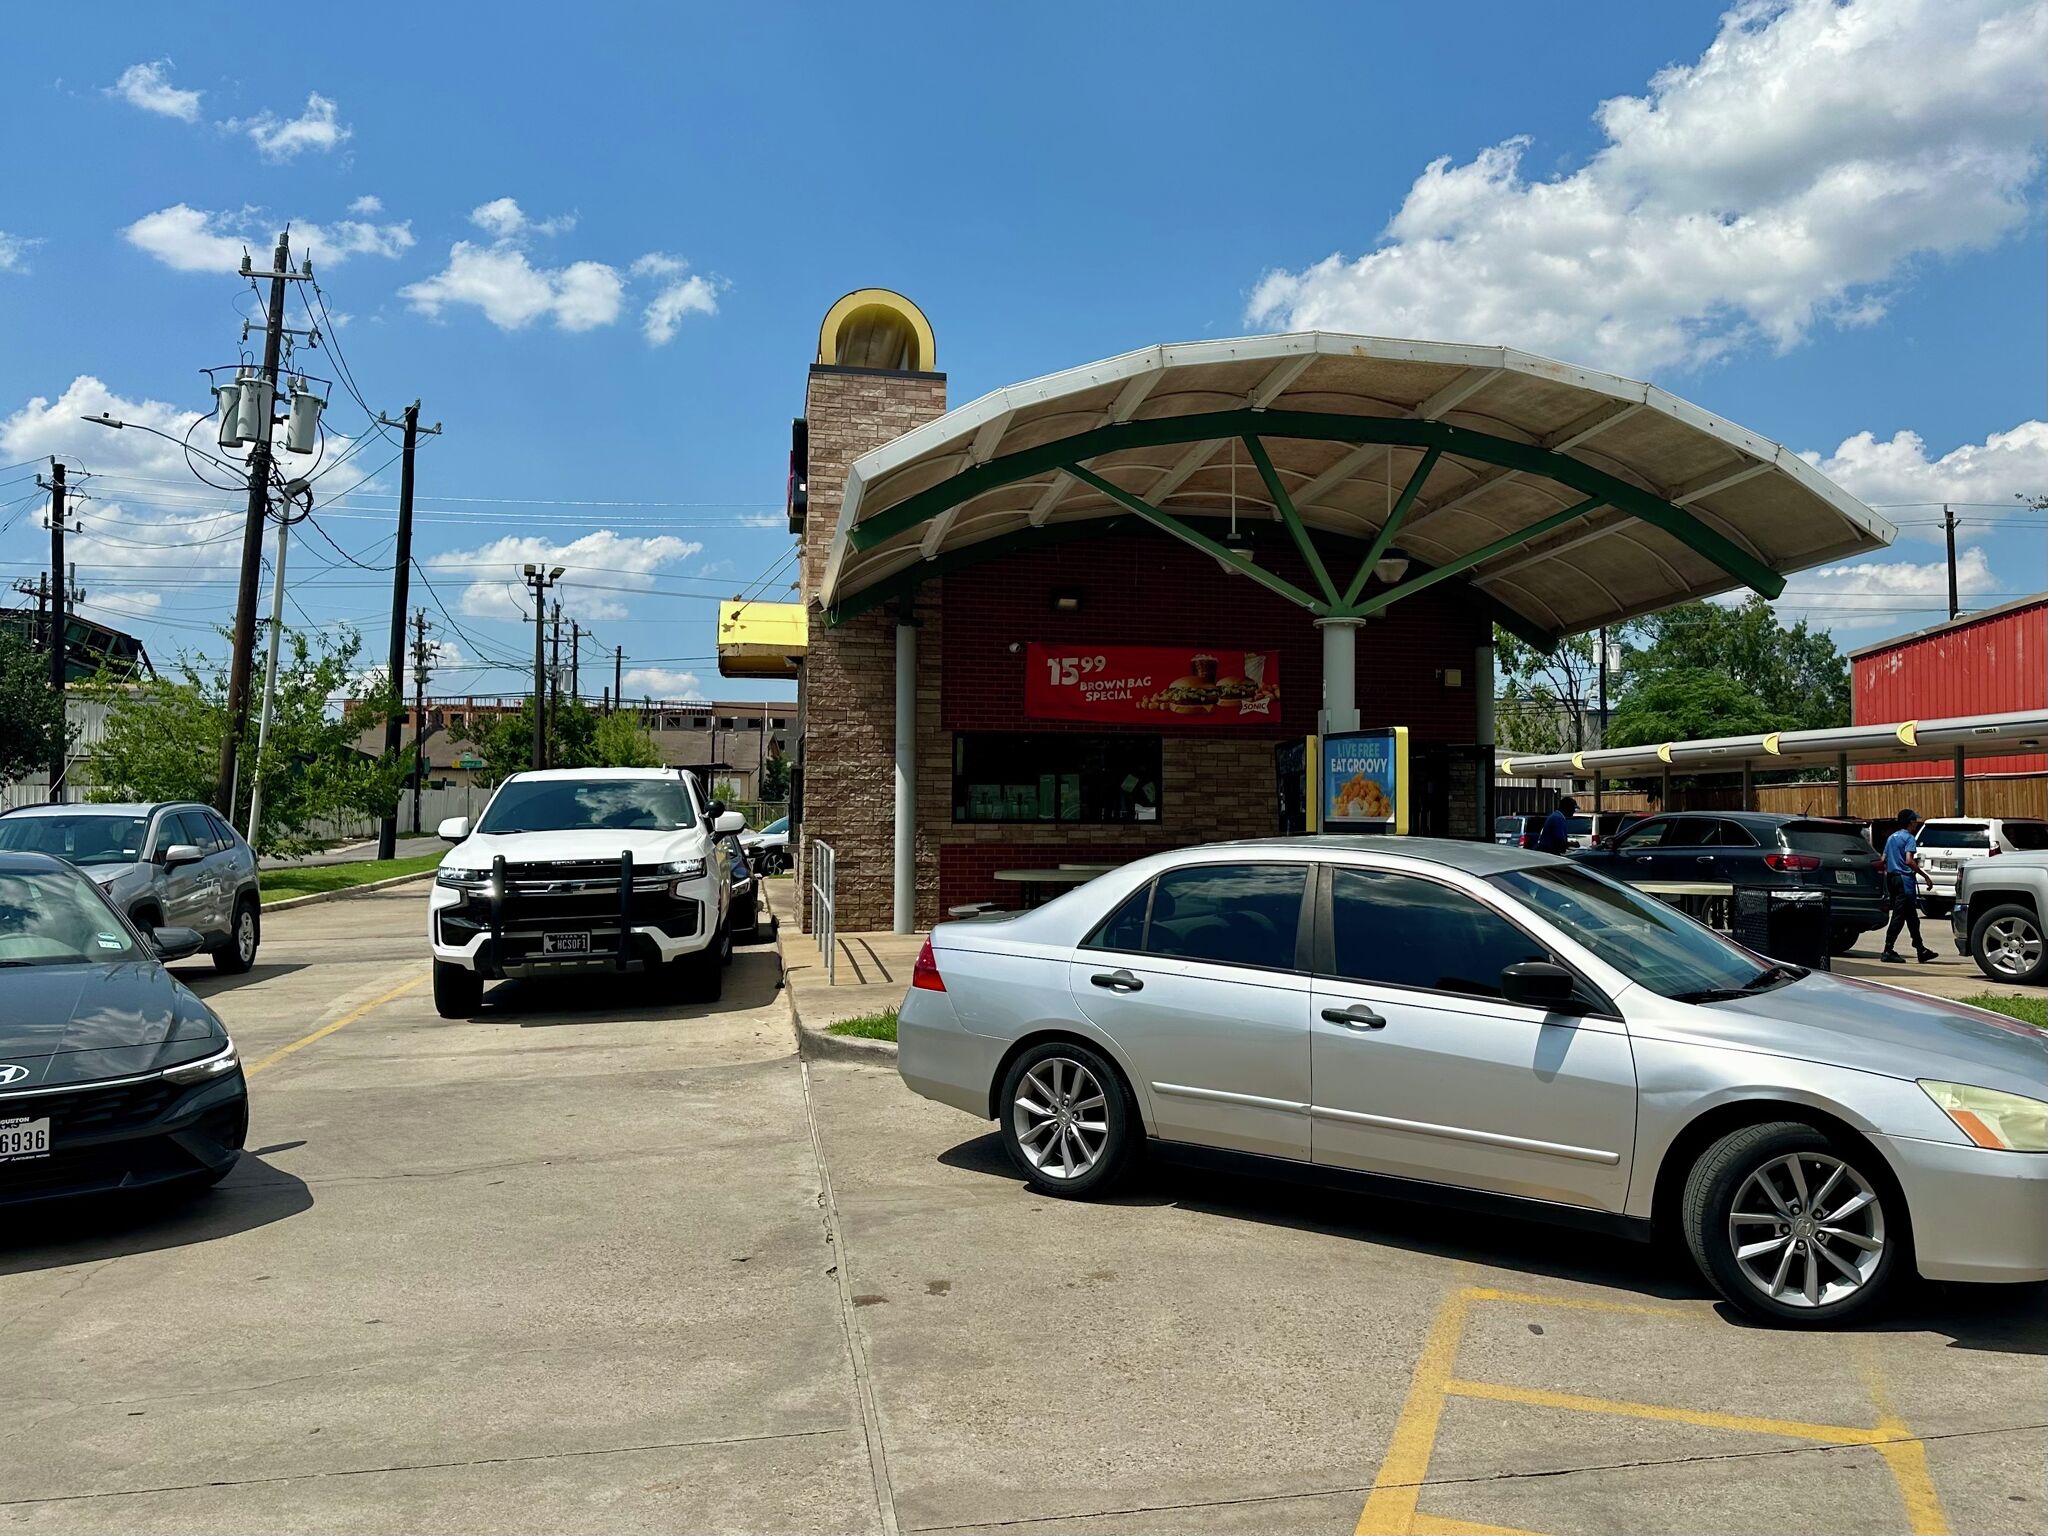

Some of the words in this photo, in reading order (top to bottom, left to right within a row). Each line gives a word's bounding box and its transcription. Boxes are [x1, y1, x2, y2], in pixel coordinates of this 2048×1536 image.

[1080, 679, 1126, 692] BROWN
[1127, 676, 1152, 688] BAG
[1085, 689, 1133, 702] SPECIAL
[1243, 702, 1266, 711] SONIC
[1337, 743, 1357, 757] LIVE
[1359, 743, 1380, 757] FREE
[1331, 758, 1347, 773] EAT
[1347, 758, 1388, 773] GROOVY
[0, 1130, 45, 1154] 6936
